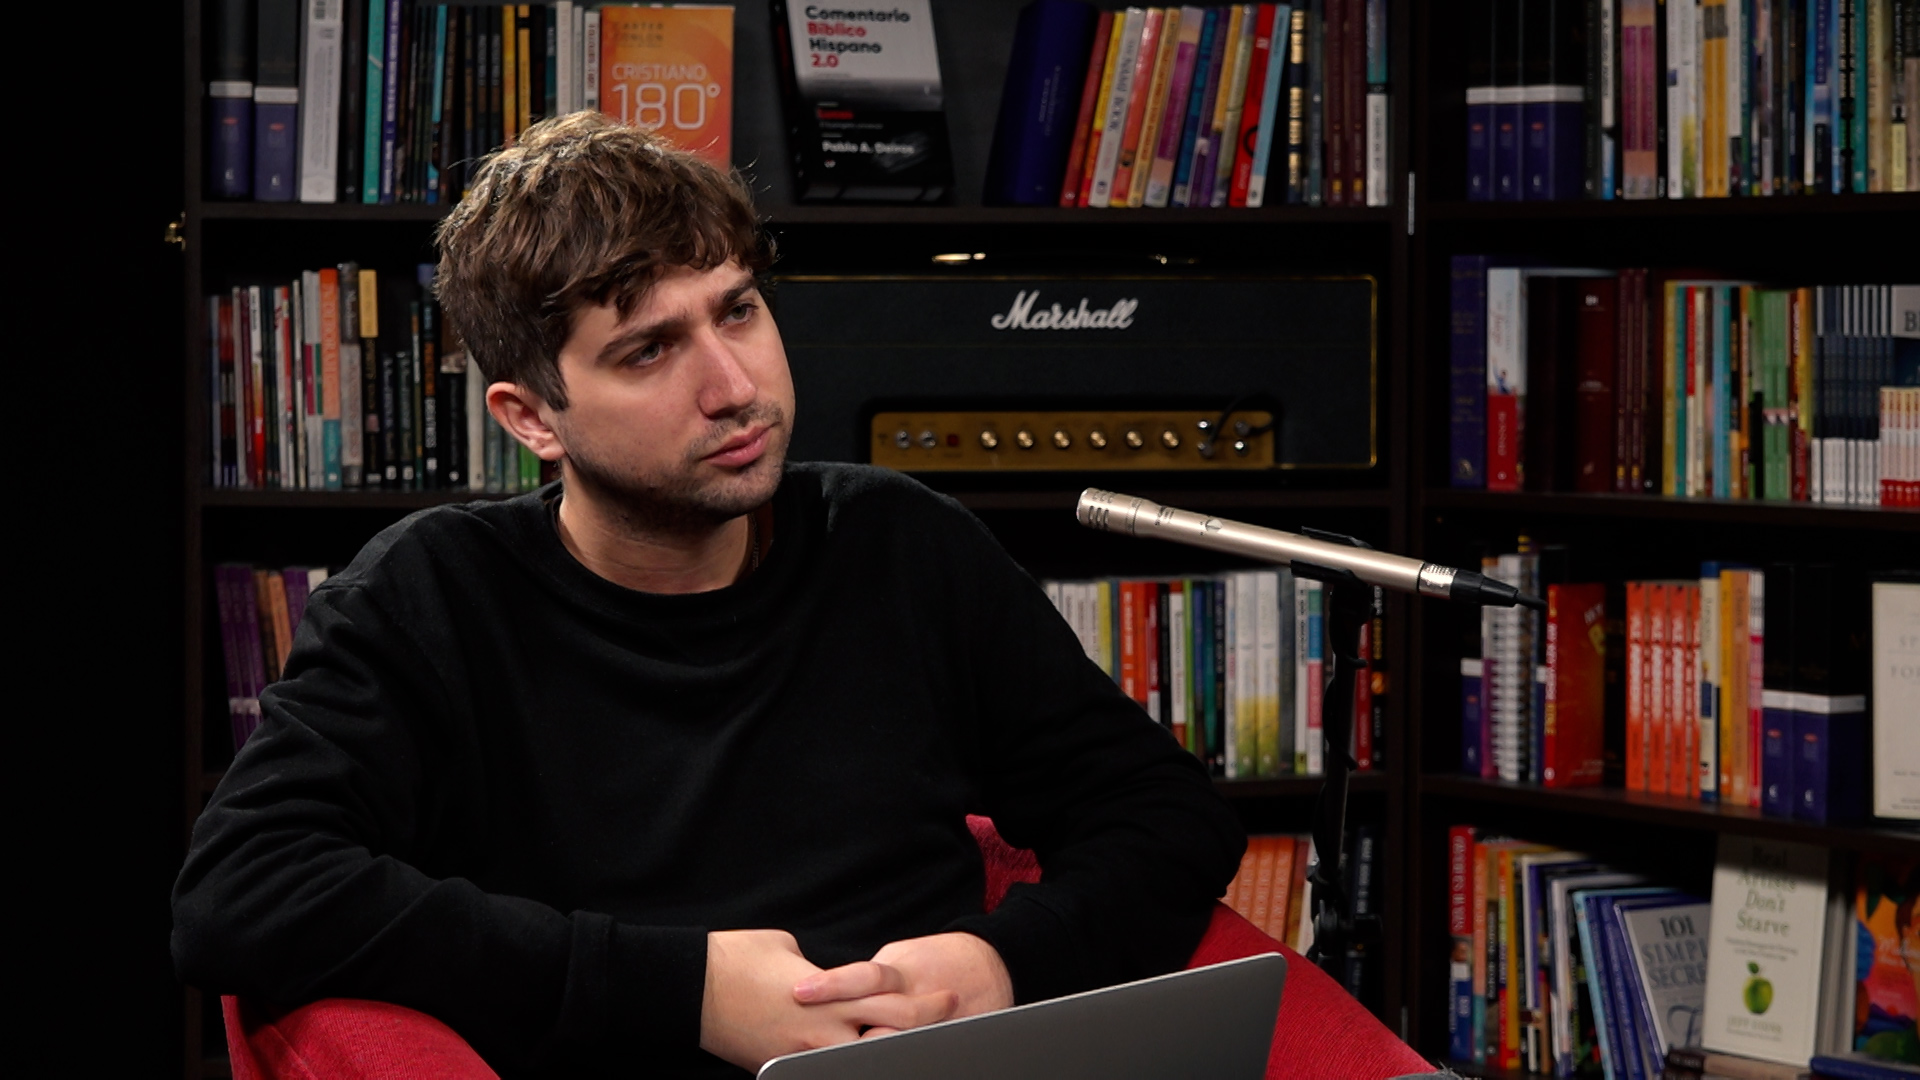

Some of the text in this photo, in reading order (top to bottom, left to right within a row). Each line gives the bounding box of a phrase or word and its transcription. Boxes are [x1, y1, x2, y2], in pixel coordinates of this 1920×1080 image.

[805, 5, 911, 23] Comentario
[810, 38, 882, 55] Hispano
[811, 53, 839, 68] 2.0
[611, 63, 707, 82] CRISTIANO
[611, 81, 722, 131] 180°
[991, 289, 1139, 331] Marshall
[1746, 891, 1786, 913] Don't
[1660, 914, 1696, 938] 101
[1736, 911, 1791, 937] Starve
